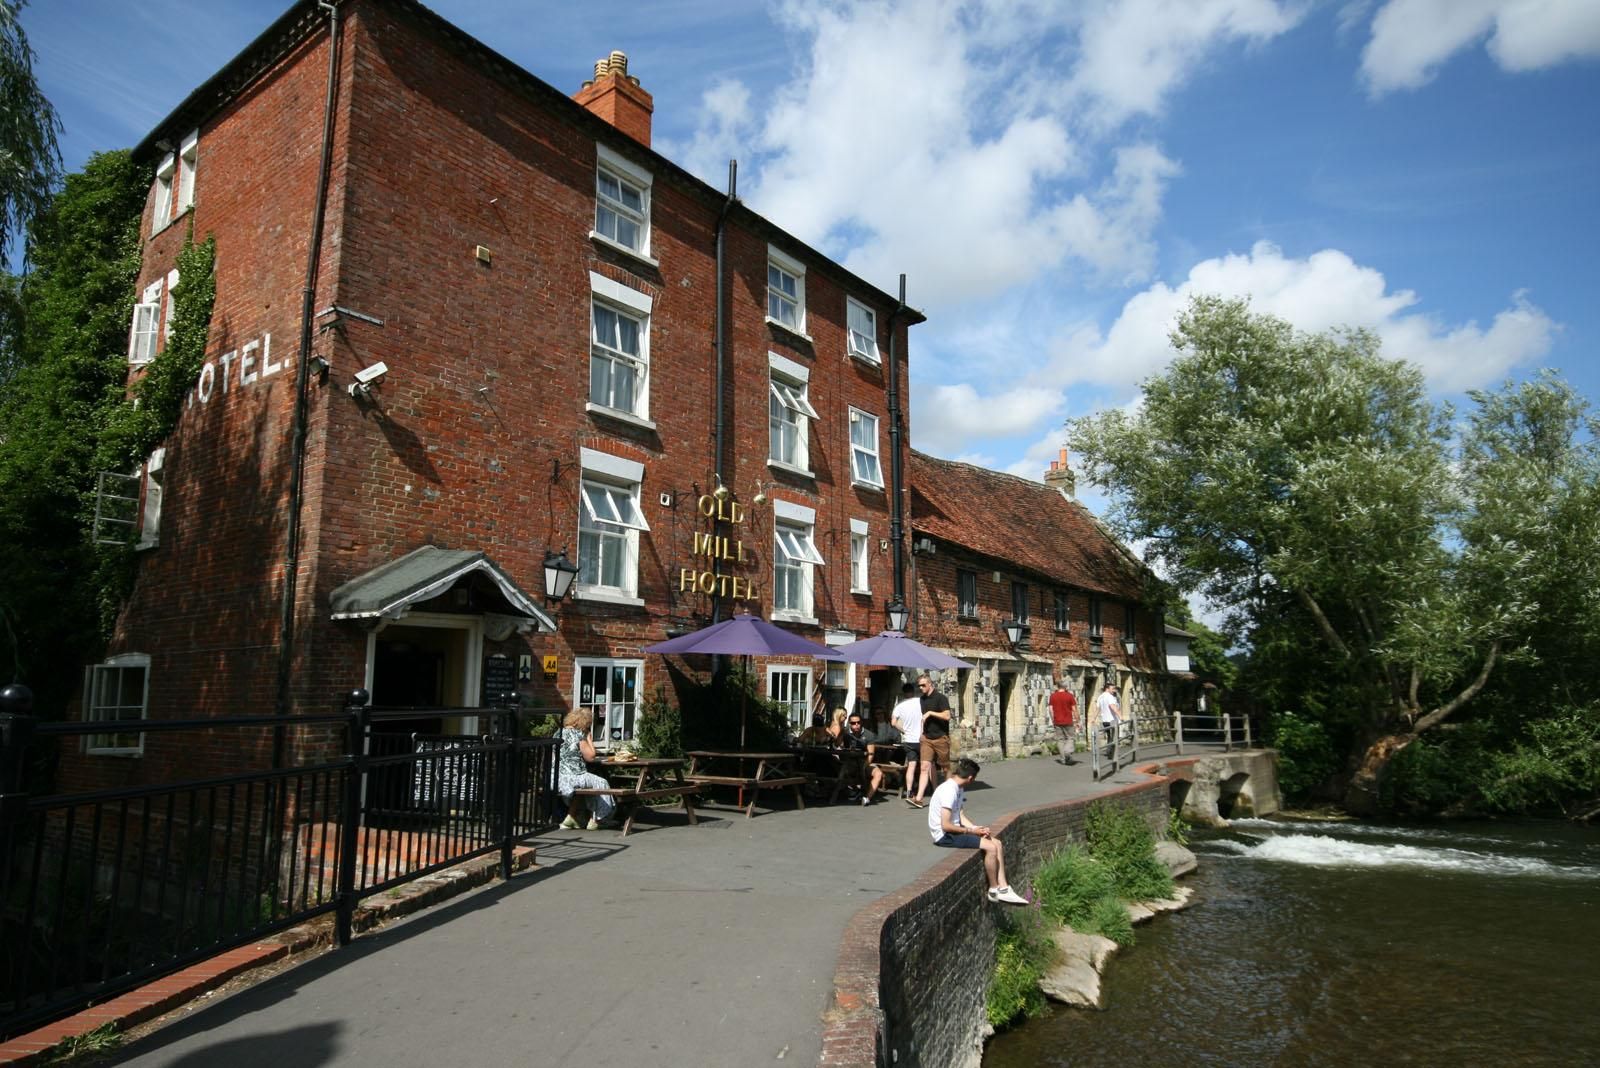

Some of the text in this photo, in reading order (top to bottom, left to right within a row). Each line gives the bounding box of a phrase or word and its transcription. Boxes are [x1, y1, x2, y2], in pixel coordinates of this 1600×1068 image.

[699, 494, 744, 524] OLD
[694, 531, 748, 562] MILL
[680, 568, 759, 600] HOTEL
[545, 660, 557, 670] AA
